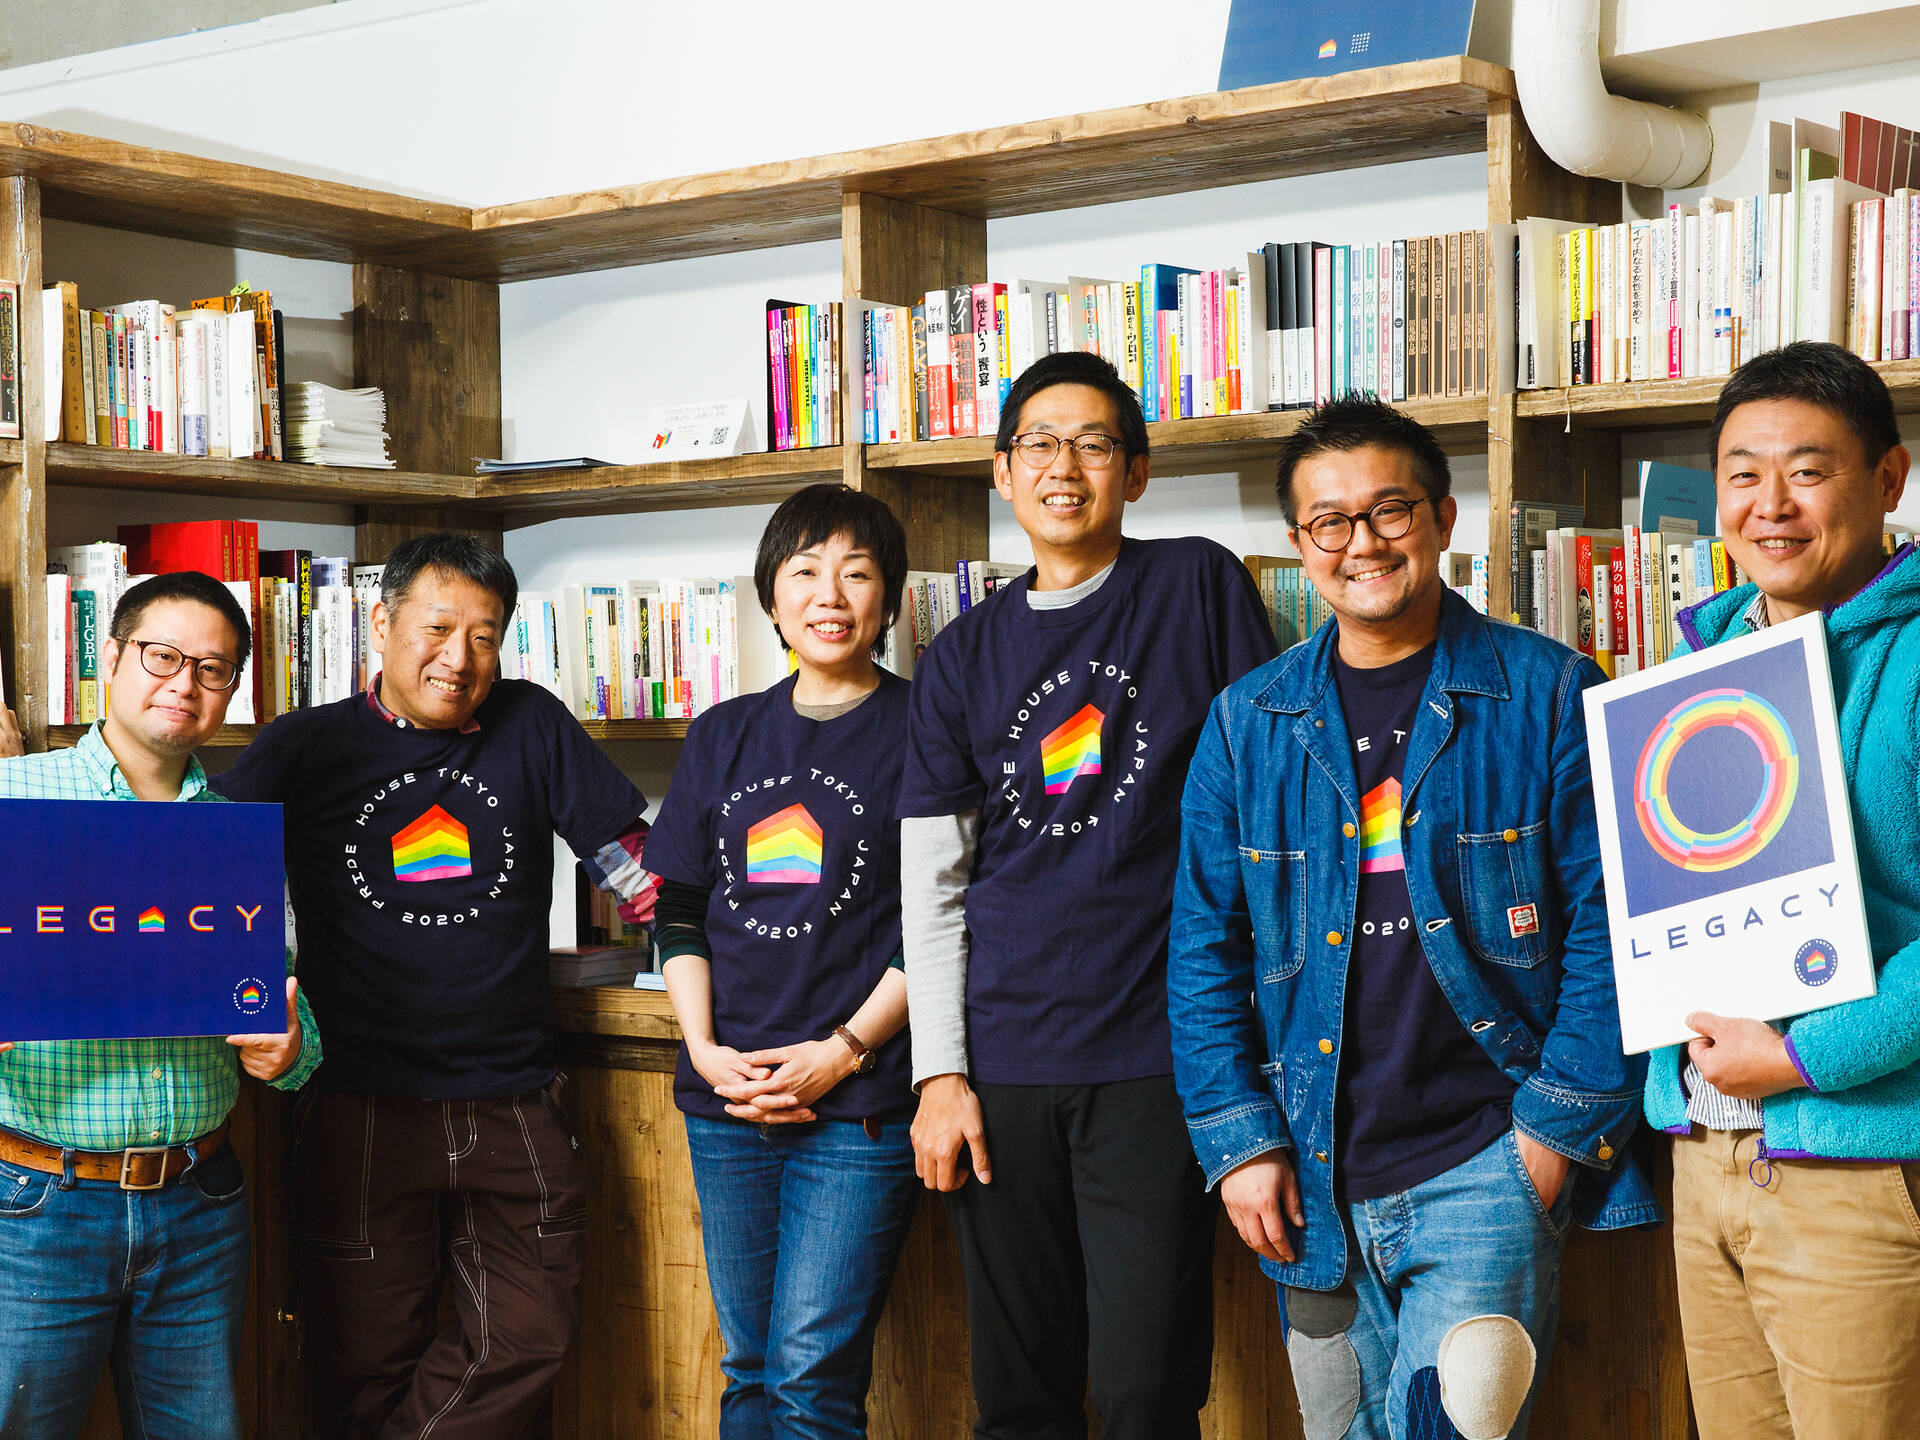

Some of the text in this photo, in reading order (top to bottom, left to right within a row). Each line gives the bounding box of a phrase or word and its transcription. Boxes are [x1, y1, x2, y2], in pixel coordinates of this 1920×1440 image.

[952, 288, 974, 333] ゲイ
[956, 341, 974, 403] 増補版
[917, 585, 927, 642] ロック・ハドソン
[1613, 560, 1625, 622] 男の娘たち
[83, 615, 97, 668] LGBT
[1009, 670, 1071, 739] HOUSE
[1113, 721, 1148, 802] JAPAN
[722, 776, 792, 816] HOUSE
[811, 768, 864, 816] TOKYO
[345, 767, 514, 926] PRIDE HOUSE TOKYO JAPAN 2020
[829, 840, 868, 916] JAPAN
[745, 918, 798, 939] 2020
[1362, 917, 1410, 936] 020
[1631, 883, 1839, 959] LEGACY
